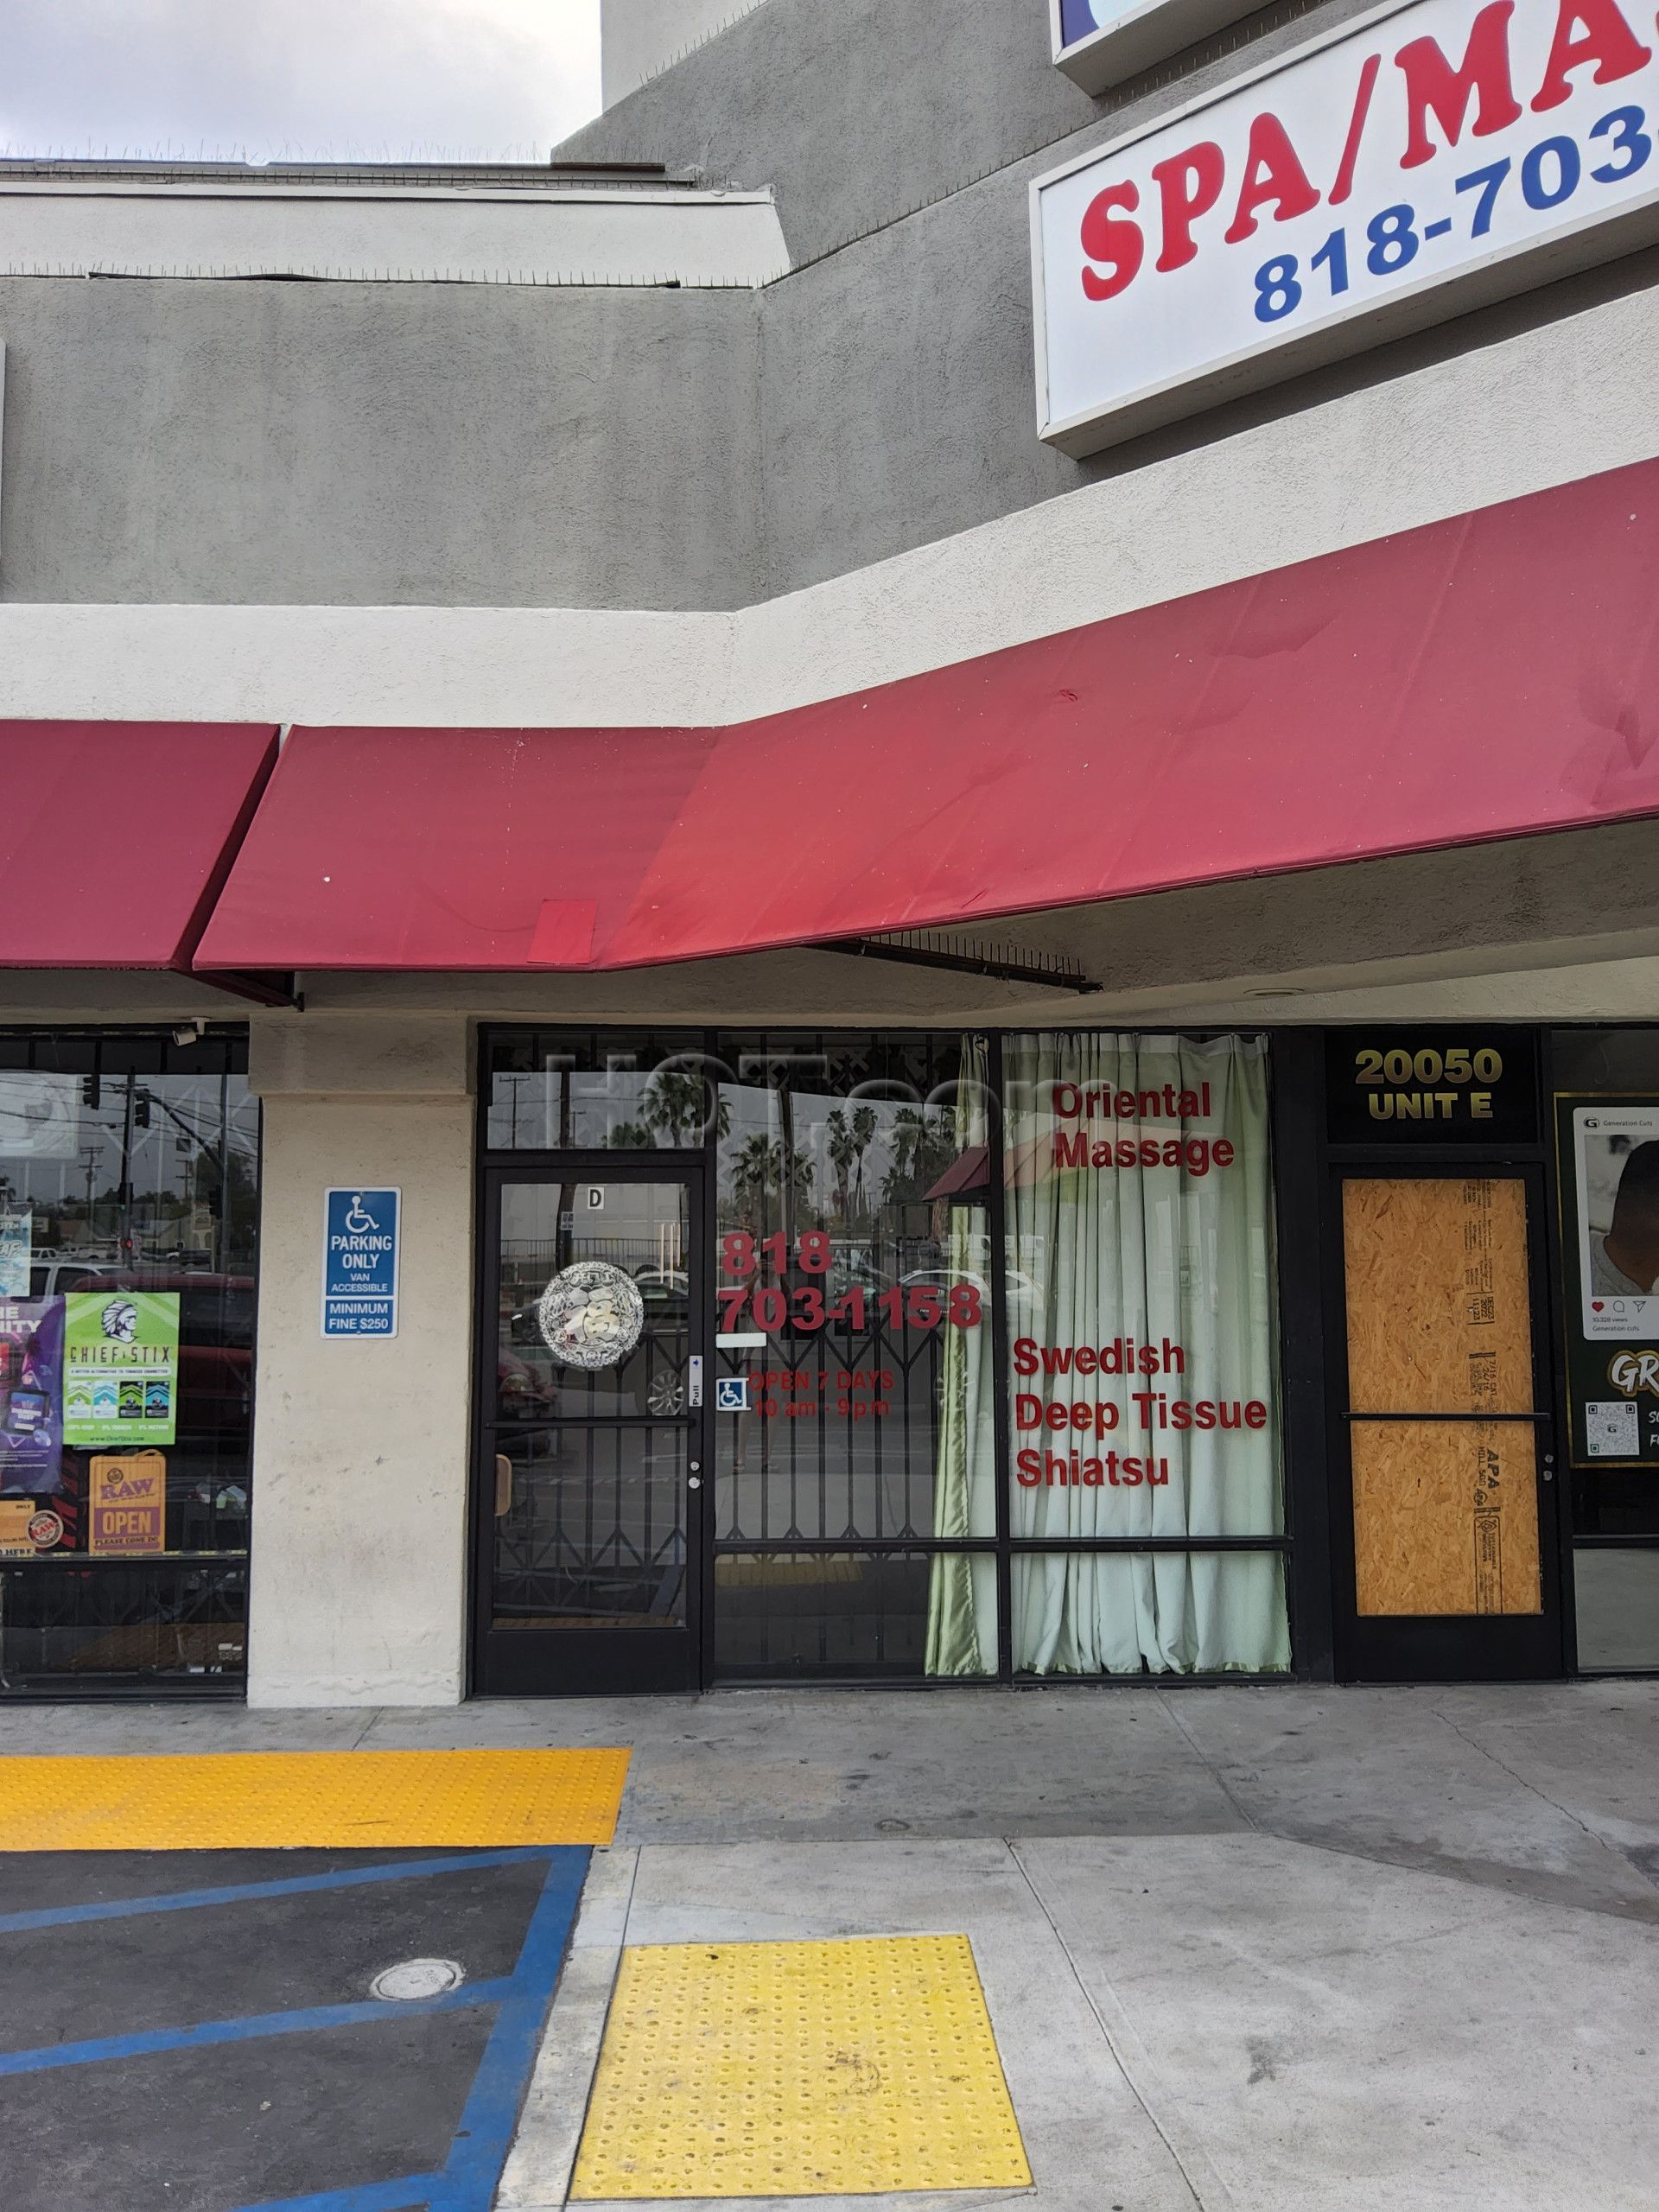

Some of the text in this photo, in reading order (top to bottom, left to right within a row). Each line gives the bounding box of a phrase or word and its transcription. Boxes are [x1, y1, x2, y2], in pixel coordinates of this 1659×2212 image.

[1080, 0, 1659, 301] SPA/MA
[1254, 105, 1659, 323] 818-703
[1355, 1048, 1503, 1084] 20050
[1052, 1083, 1210, 1118] Oriental
[1369, 1092, 1493, 1120] UNIT E
[1054, 1133, 1234, 1176] Massage
[589, 1189, 602, 1207] D
[331, 1236, 392, 1251] PARKING
[721, 1230, 831, 1275] 818
[342, 1254, 380, 1268] ONLY
[331, 1283, 388, 1293] ACCESSIBLE
[350, 1273, 370, 1281] VAN
[329, 1303, 388, 1314] MINIMUM
[717, 1284, 982, 1332] 703-1158
[329, 1318, 389, 1329] FINE $250
[70, 1346, 169, 1363] CHIEF STIX
[1014, 1338, 1185, 1376] Swedish
[748, 1370, 895, 1391] OPEN 7 DAYS
[755, 1399, 776, 1417] 10
[784, 1401, 817, 1417] am
[1015, 1393, 1267, 1440] Deep Tissue
[1017, 1449, 1169, 1487] Shiatsu
[1487, 1449, 1501, 1490] APA
[100, 1478, 155, 1500] RAW
[31, 1522, 56, 1538] RAW
[102, 1510, 152, 1534] OPEN
